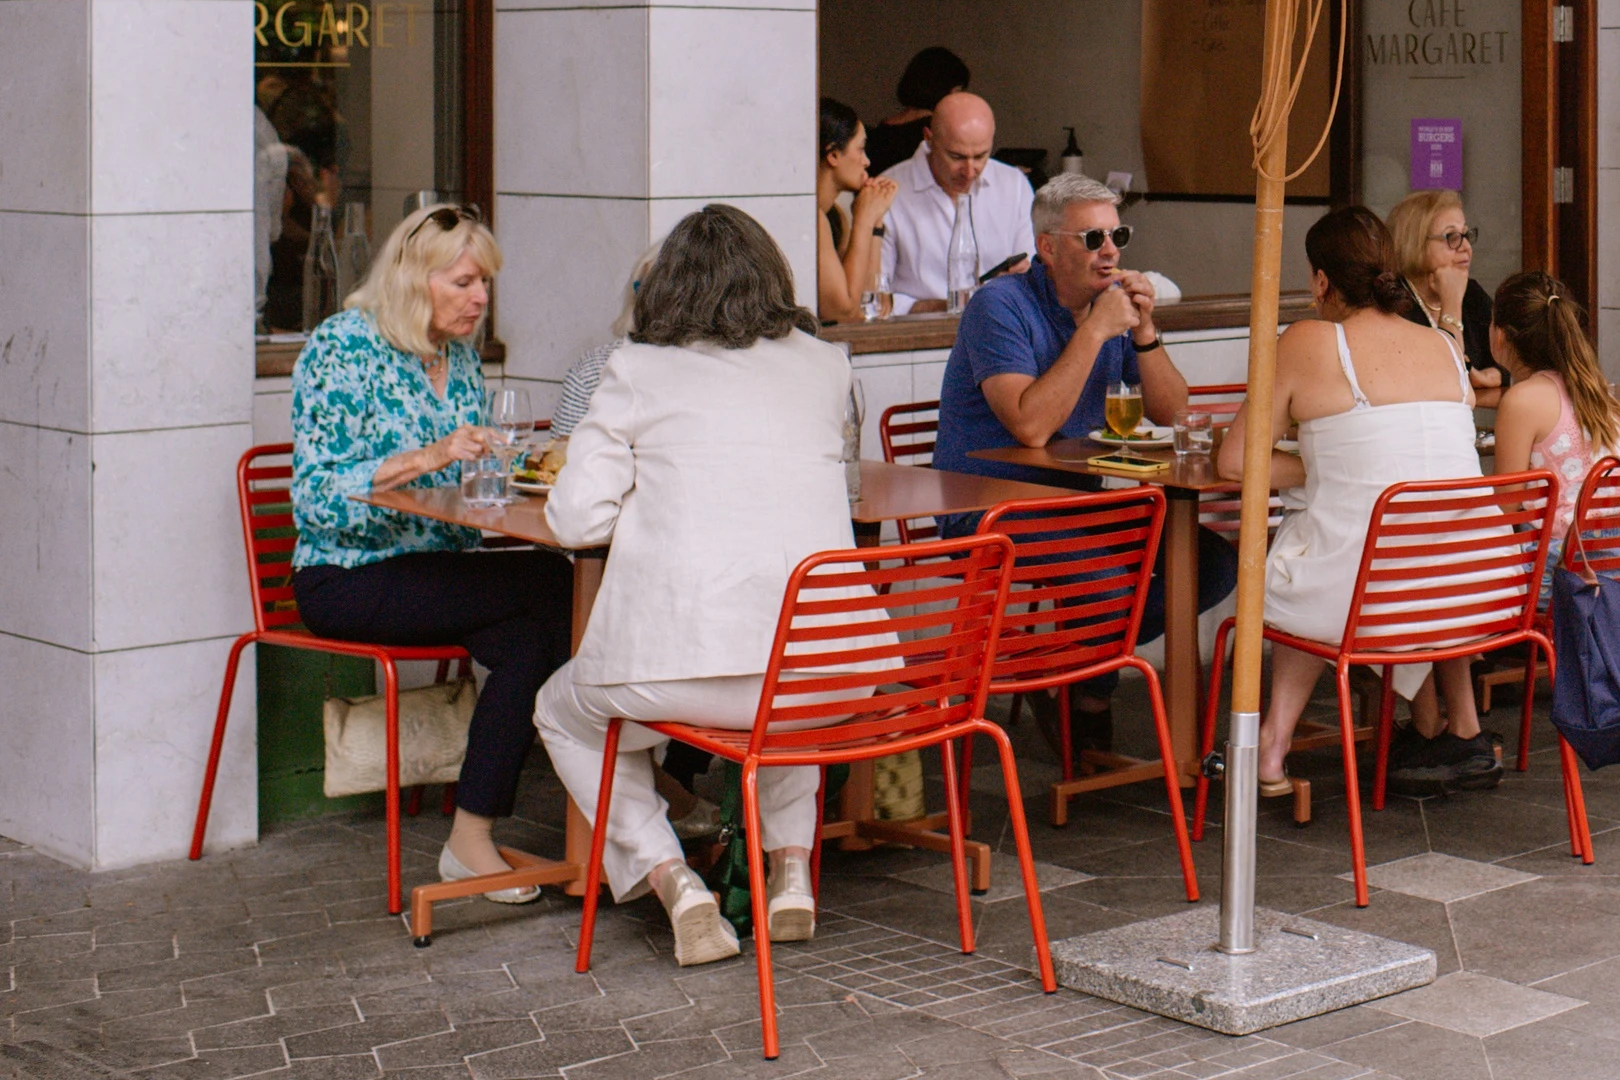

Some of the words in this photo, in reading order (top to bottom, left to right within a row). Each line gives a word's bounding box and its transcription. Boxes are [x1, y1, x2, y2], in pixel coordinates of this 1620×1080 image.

[255, 1, 422, 47] RGARET
[1365, 31, 1509, 66] MARGARET
[1418, 132, 1455, 142] BURGERS
